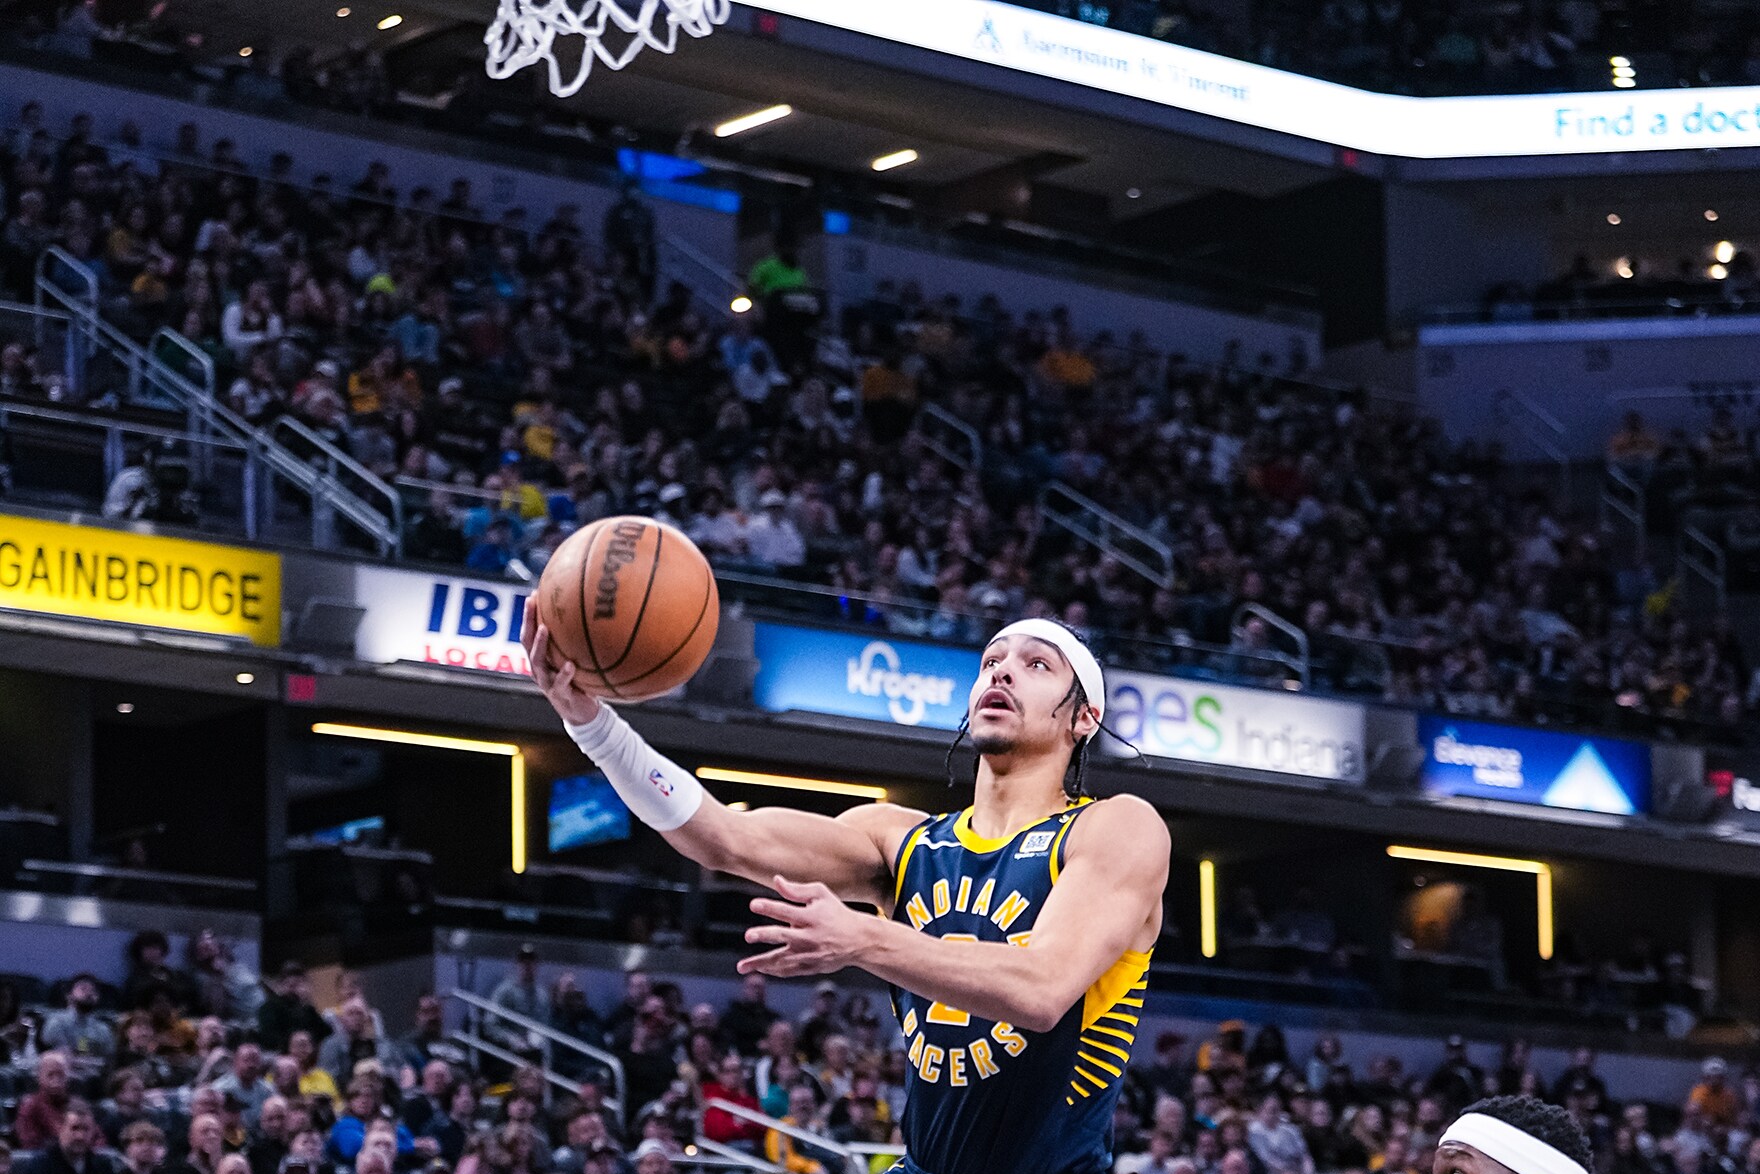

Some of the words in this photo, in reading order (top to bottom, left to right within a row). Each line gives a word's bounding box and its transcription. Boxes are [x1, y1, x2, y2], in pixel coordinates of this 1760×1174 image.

[1555, 105, 1634, 137] Find
[1649, 113, 1669, 134] a
[0, 541, 261, 621] GAINBRIDGE
[593, 521, 647, 620] Wilson
[847, 640, 956, 725] Kroger
[1111, 684, 1223, 754] aes
[905, 875, 1033, 948] NDIAN
[902, 1007, 1028, 1087] PACERS
